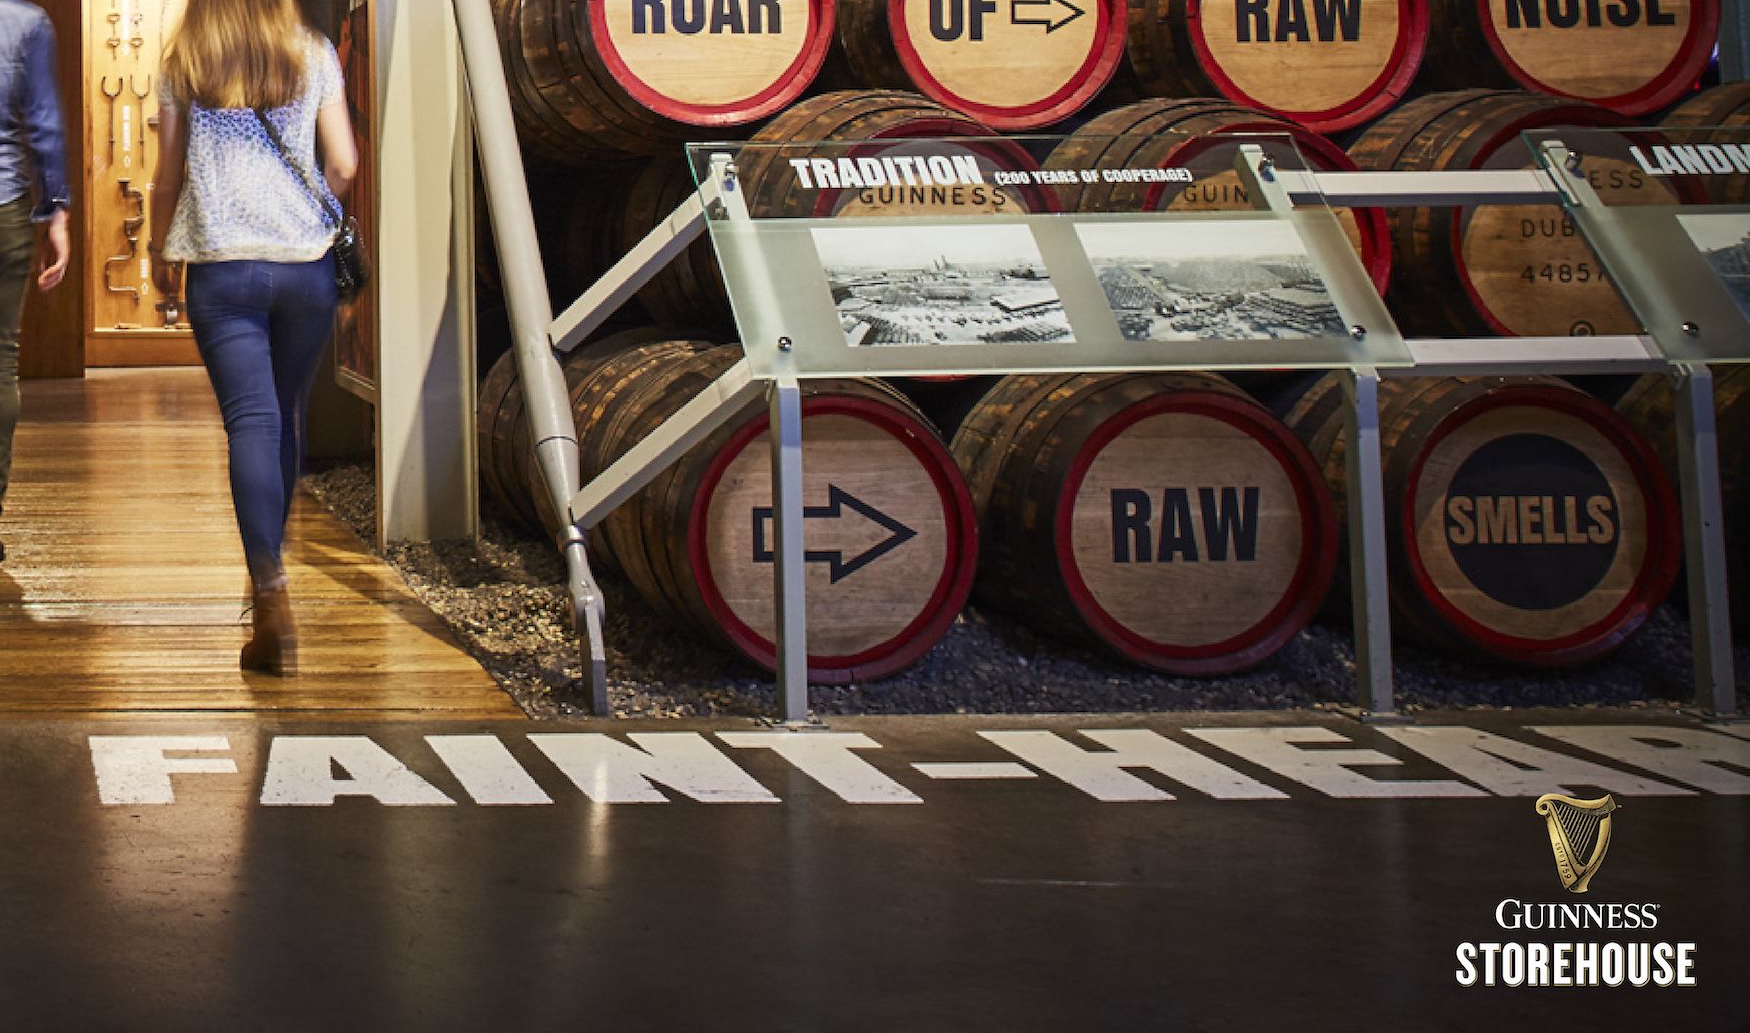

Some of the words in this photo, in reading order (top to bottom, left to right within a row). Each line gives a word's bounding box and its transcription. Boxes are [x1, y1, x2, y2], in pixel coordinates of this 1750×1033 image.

[789, 155, 985, 189] TRADITION
[993, 169, 1029, 186] (200
[1031, 170, 1078, 185] YEARS
[1081, 169, 1100, 184] OF
[1102, 167, 1193, 184] COOPERAGE)
[858, 186, 1006, 207] GUINNESS
[1184, 184, 1249, 204] GUIN
[1520, 218, 1575, 238] DUB
[1111, 486, 1260, 563] RAW
[1448, 495, 1614, 545] SMELLS
[92, 725, 1750, 806] FAINT-HEAR
